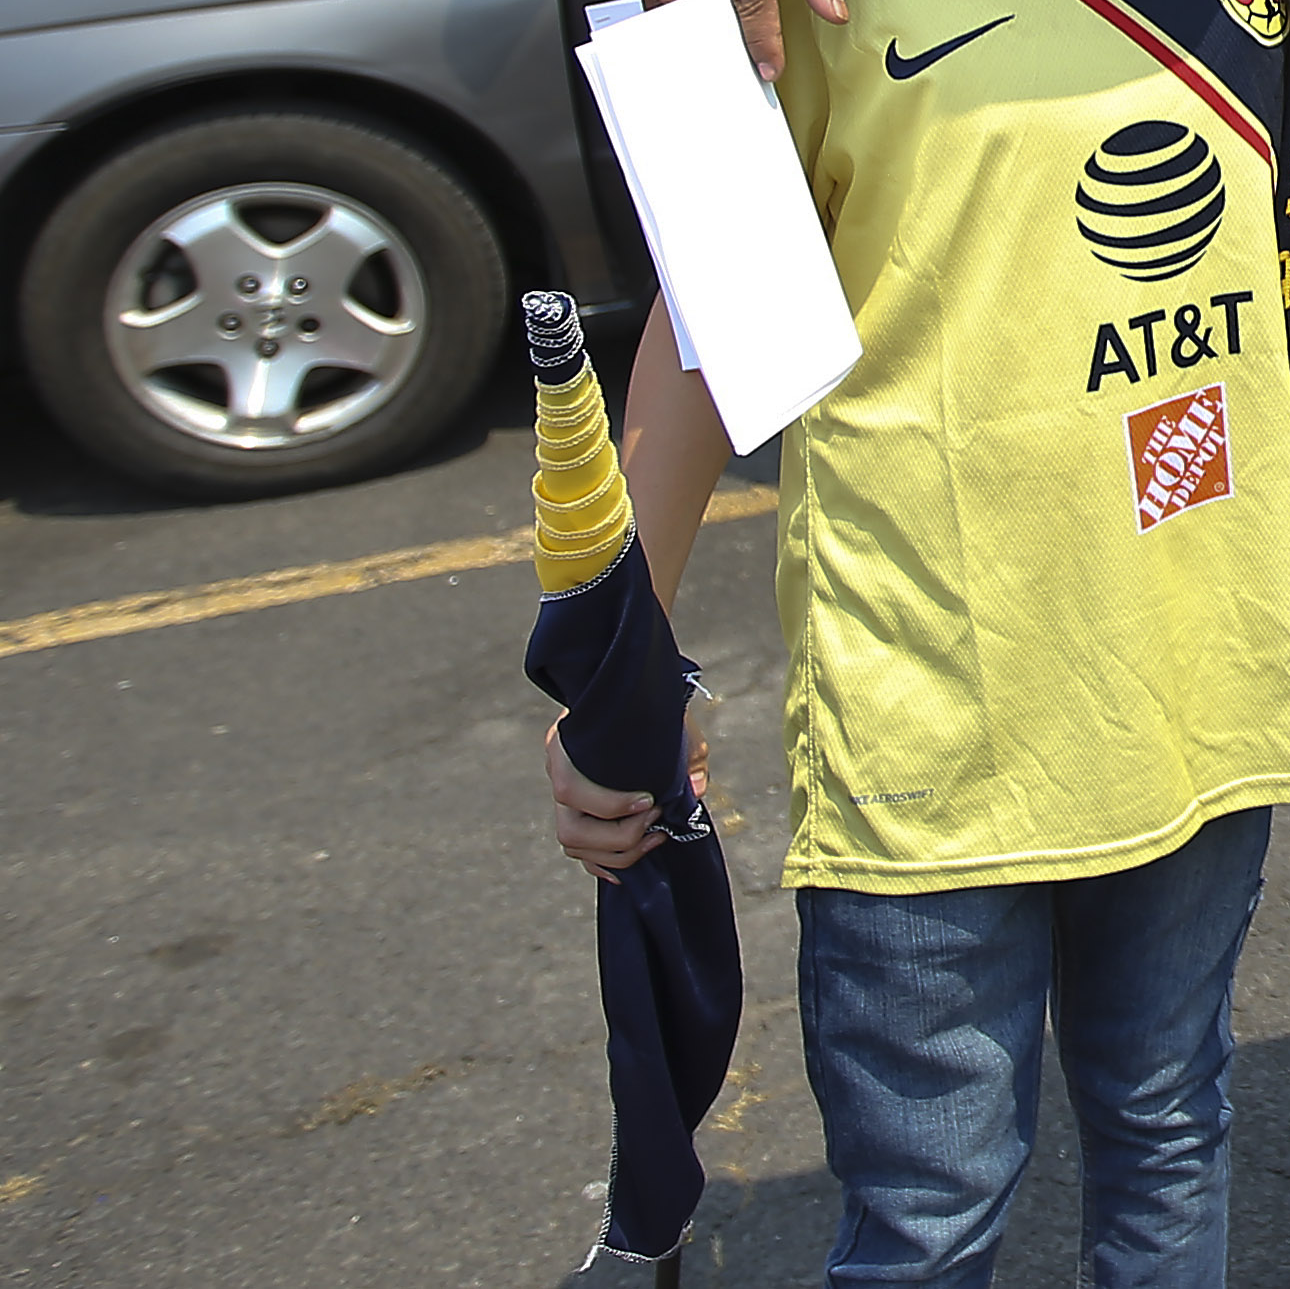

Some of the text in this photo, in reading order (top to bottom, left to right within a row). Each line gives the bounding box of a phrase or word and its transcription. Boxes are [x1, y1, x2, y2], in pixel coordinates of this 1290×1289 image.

[1085, 290, 1254, 393] AT&T
[1138, 388, 1224, 522] HOME
[1141, 414, 1178, 466] THE
[1170, 425, 1226, 509] DEPOT
